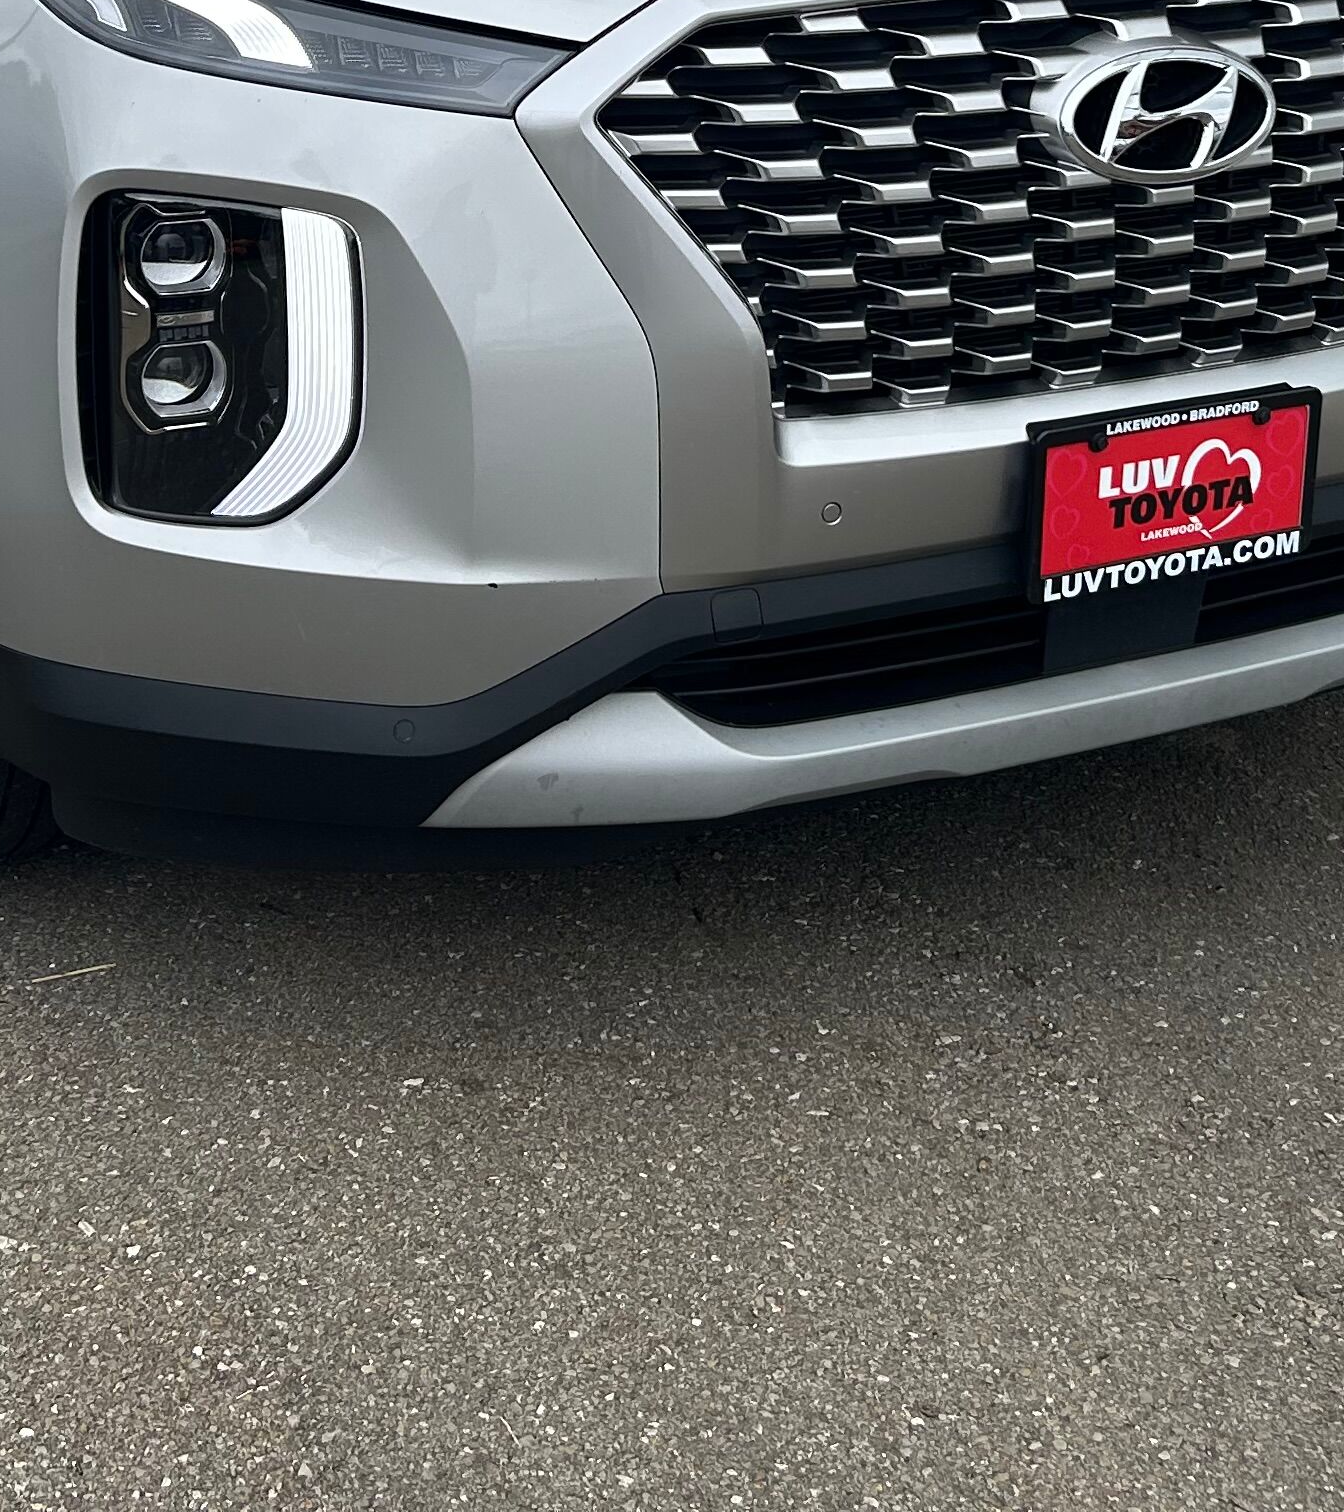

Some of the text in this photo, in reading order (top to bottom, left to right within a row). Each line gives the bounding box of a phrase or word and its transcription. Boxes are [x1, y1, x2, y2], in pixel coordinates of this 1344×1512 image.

[1106, 400, 1260, 436] LAKEWOOD BRADFORD
[1097, 454, 1181, 500] LUV
[1109, 475, 1254, 529] TOYOTA
[1140, 521, 1203, 542] LAKEWOOD
[1043, 530, 1301, 603] LUVTOYOTA.COM
